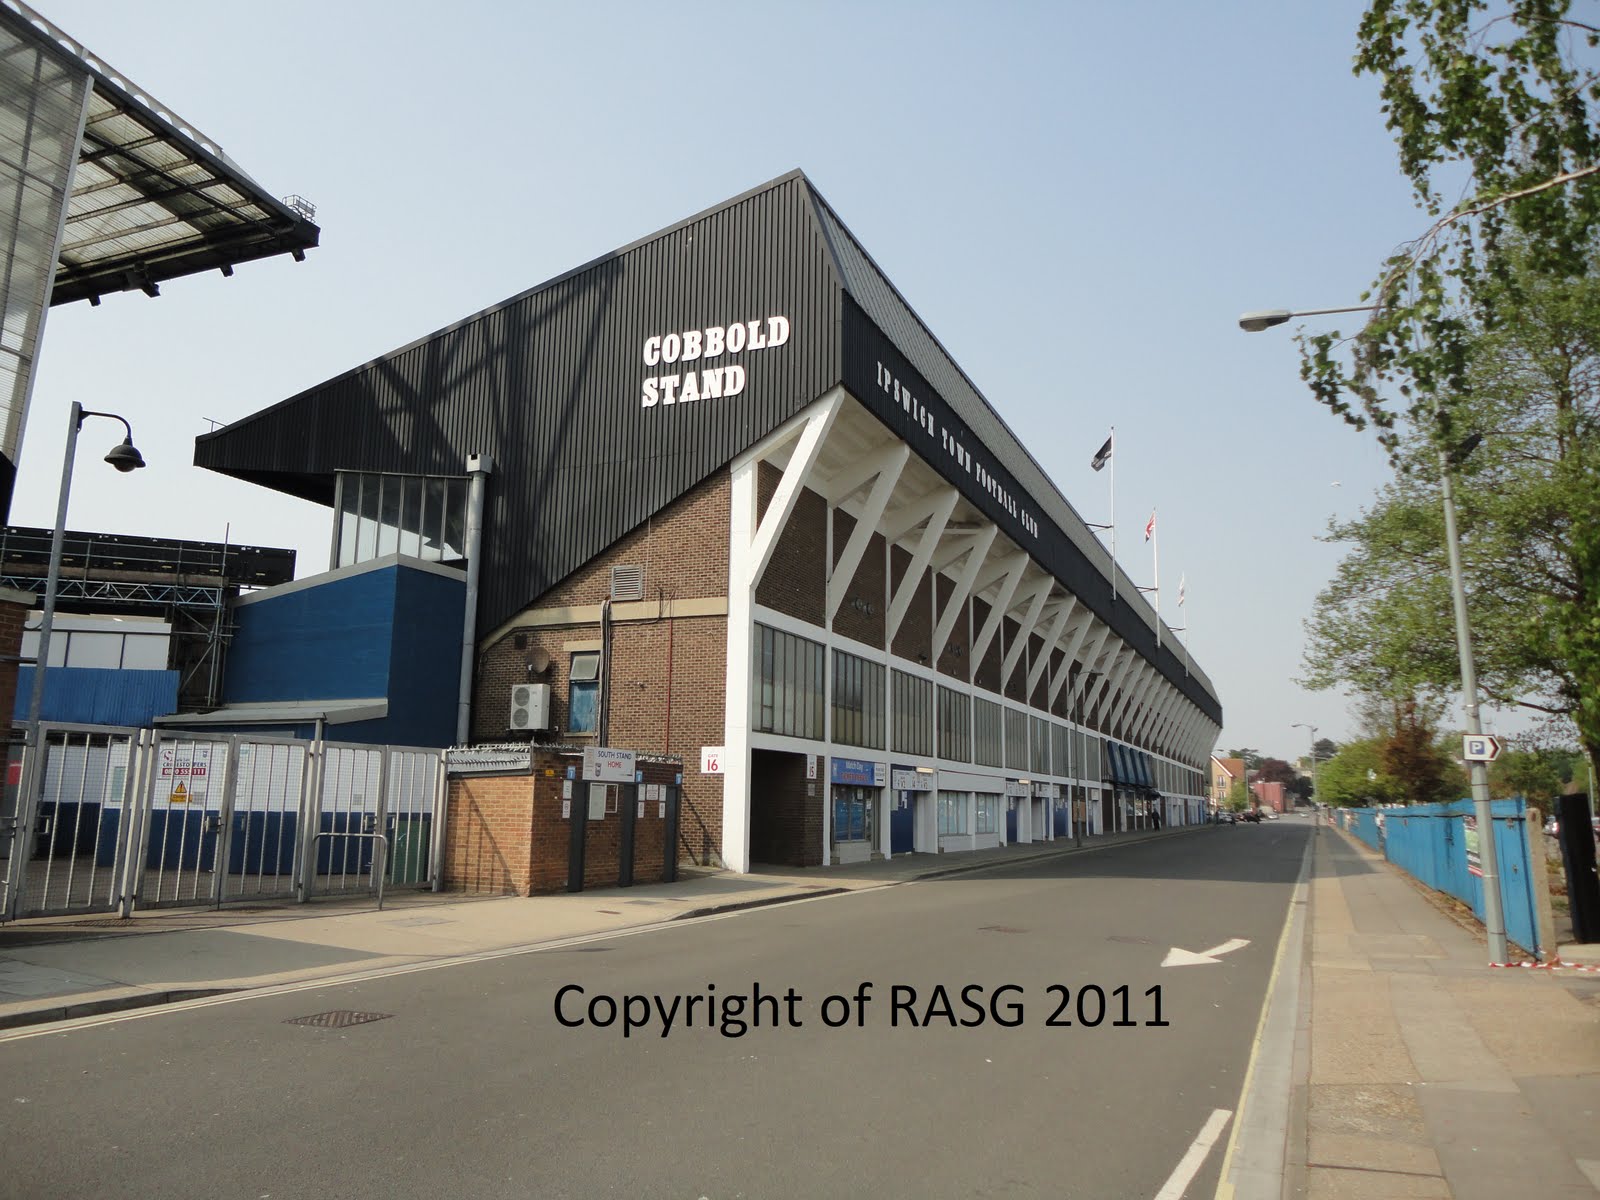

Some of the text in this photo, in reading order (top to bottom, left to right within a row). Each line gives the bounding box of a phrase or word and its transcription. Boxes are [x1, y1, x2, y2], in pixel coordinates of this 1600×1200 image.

[643, 315, 790, 367] COBBOLD
[642, 365, 746, 408] STAND
[876, 361, 1039, 539] IPSWICH TOWN FOOTBALL CLUB
[598, 750, 632, 760] SOUTH STAND
[1471, 742, 1482, 754] P
[707, 759, 719, 772] 16
